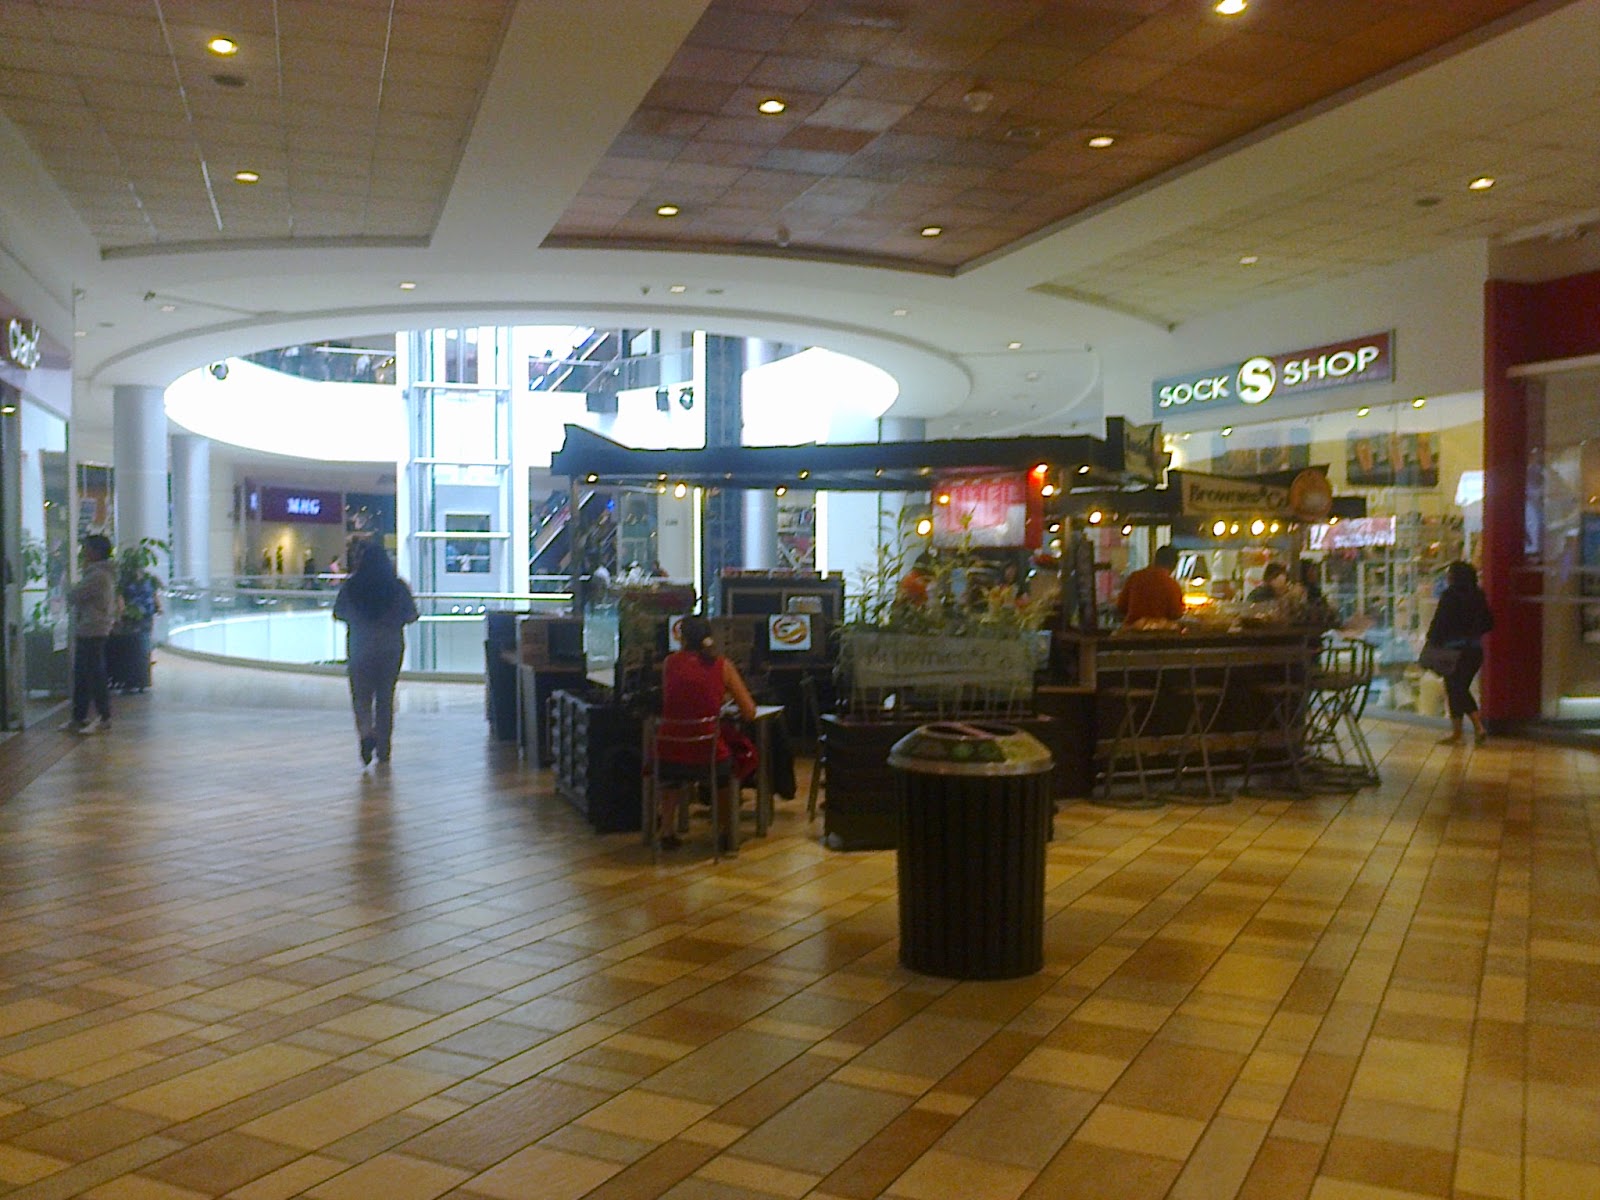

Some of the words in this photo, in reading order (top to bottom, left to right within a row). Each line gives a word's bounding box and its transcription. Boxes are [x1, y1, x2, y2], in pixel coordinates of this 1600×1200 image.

[1159, 376, 1231, 408] SOCK
[1238, 356, 1276, 404] S
[1283, 346, 1380, 385] SHOP
